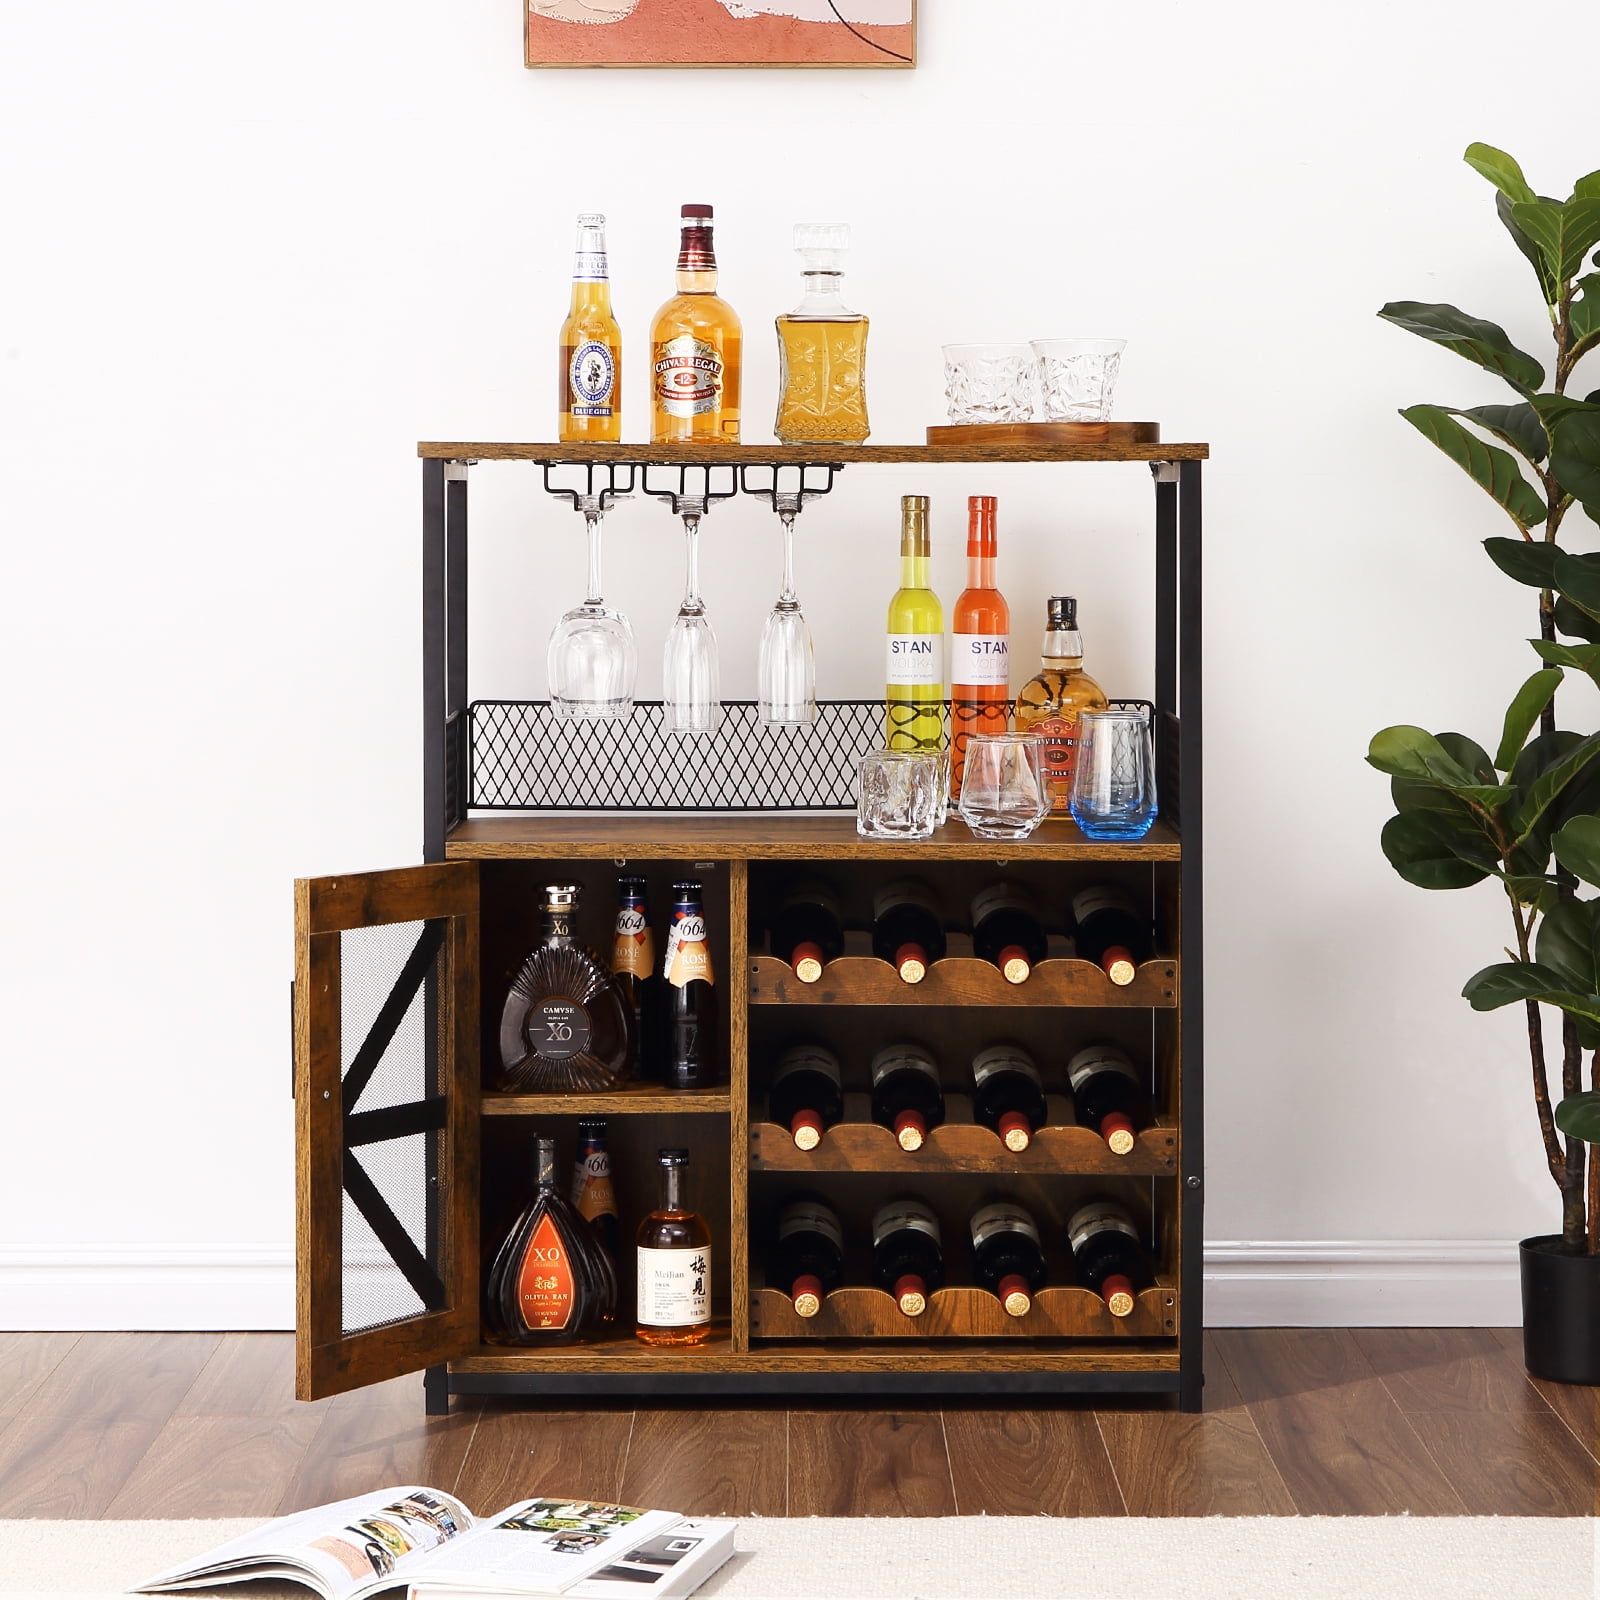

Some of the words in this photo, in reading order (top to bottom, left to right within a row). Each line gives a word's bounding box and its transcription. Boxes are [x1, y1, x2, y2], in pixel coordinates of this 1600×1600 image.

[655, 358, 685, 373] CHIVAS
[687, 358, 720, 373] REGAL
[891, 640, 932, 654] STAN
[971, 641, 1008, 655] STAN
[618, 913, 643, 930] 664
[588, 1156, 607, 1172] 166
[591, 1191, 609, 1201] ROS
[534, 1247, 560, 1262] XO
[524, 1293, 549, 1301] OLIVIA
